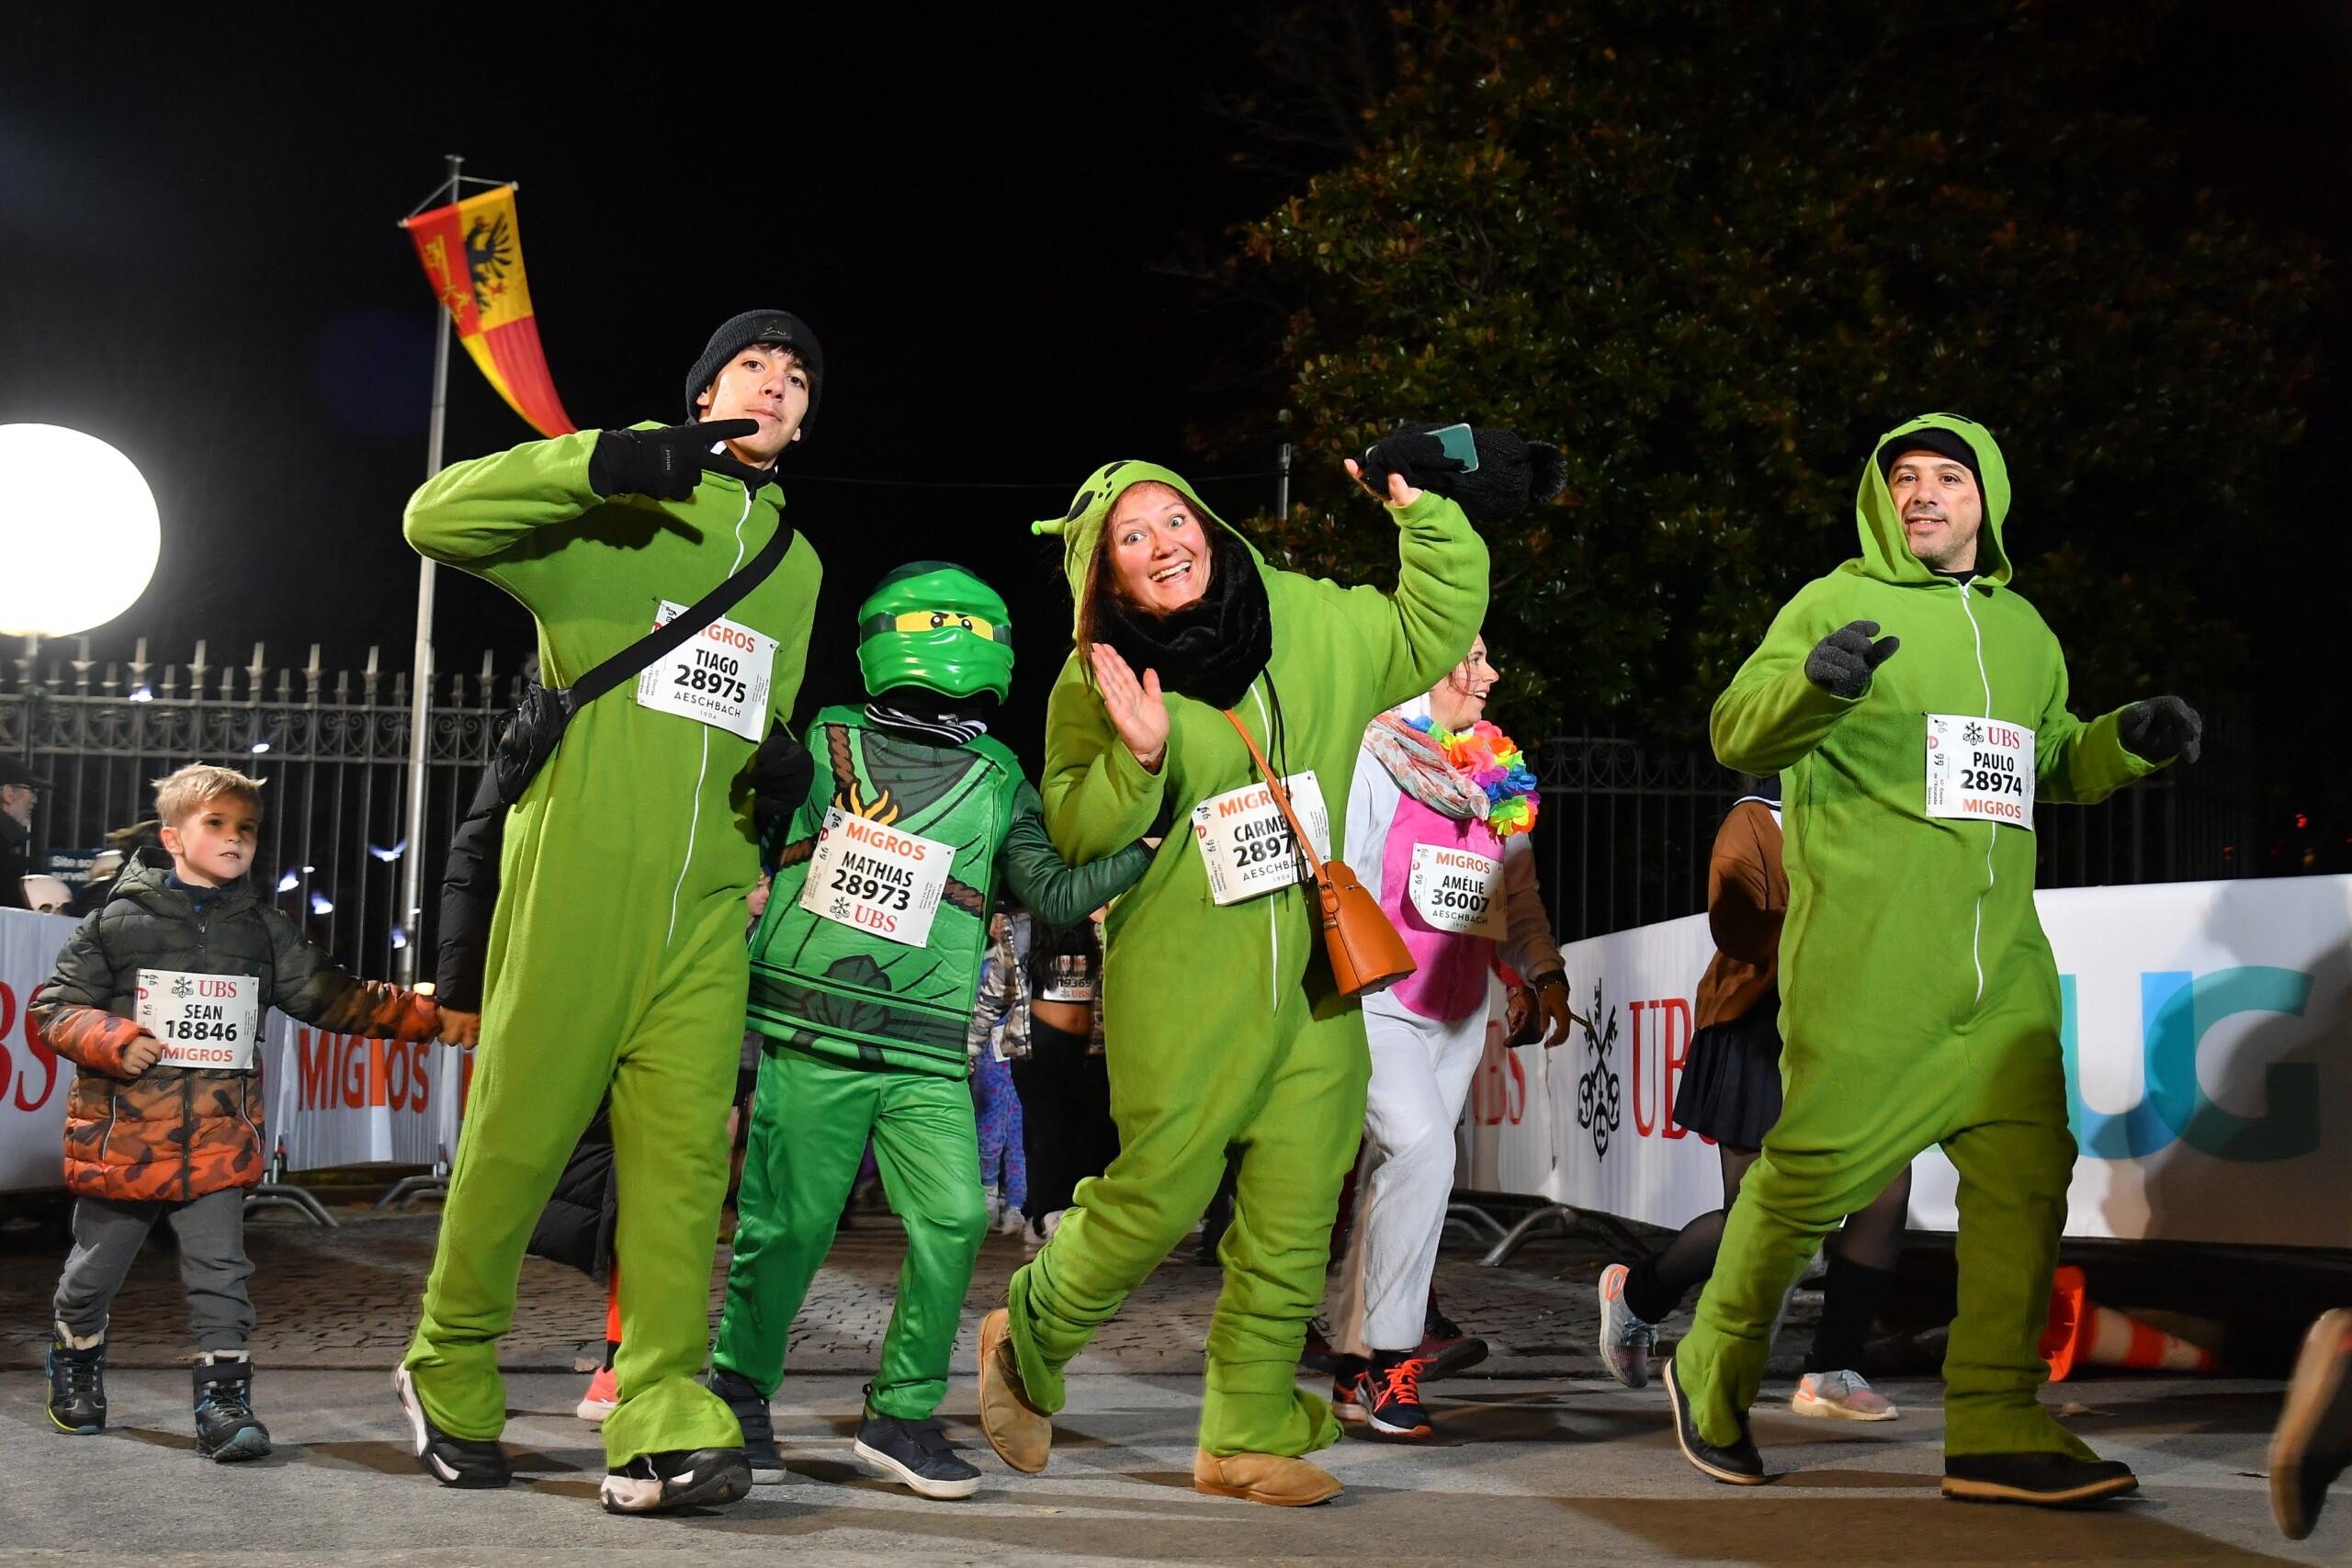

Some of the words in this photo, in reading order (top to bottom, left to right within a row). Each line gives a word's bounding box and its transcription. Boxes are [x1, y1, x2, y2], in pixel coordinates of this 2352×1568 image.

[695, 624, 755, 653] IGROS
[695, 649, 739, 676] TIAGO
[674, 664, 747, 703] 28975
[674, 691, 741, 718] AESCHBACH
[700, 710, 717, 720] 1904
[1987, 726, 2019, 750] UBS
[1973, 751, 2014, 772] PAULO
[1961, 769, 2022, 796] 28974
[1218, 784, 1294, 818] MIGRS
[1962, 798, 2021, 819] MIGROS
[846, 822, 927, 861] MIGROS
[1234, 815, 1287, 842] CARME
[1233, 834, 1292, 867] 2897
[1435, 852, 1490, 874] MIGROS
[842, 851, 914, 887] MATHIAS
[1243, 858, 1309, 881] AESCHBA
[831, 869, 910, 911] 28973
[1442, 875, 1484, 895] AMÉLIE
[1431, 889, 1490, 913] 36007
[854, 904, 898, 933] UBS
[1432, 909, 1487, 924] AESCHBACH
[198, 980, 237, 998] UBS
[184, 1004, 222, 1020] SEAN
[165, 1020, 237, 1042] 18846
[164, 1047, 233, 1062] MIGROS
[2058, 965, 2321, 1163] UG
[1629, 998, 1718, 1145] UB
